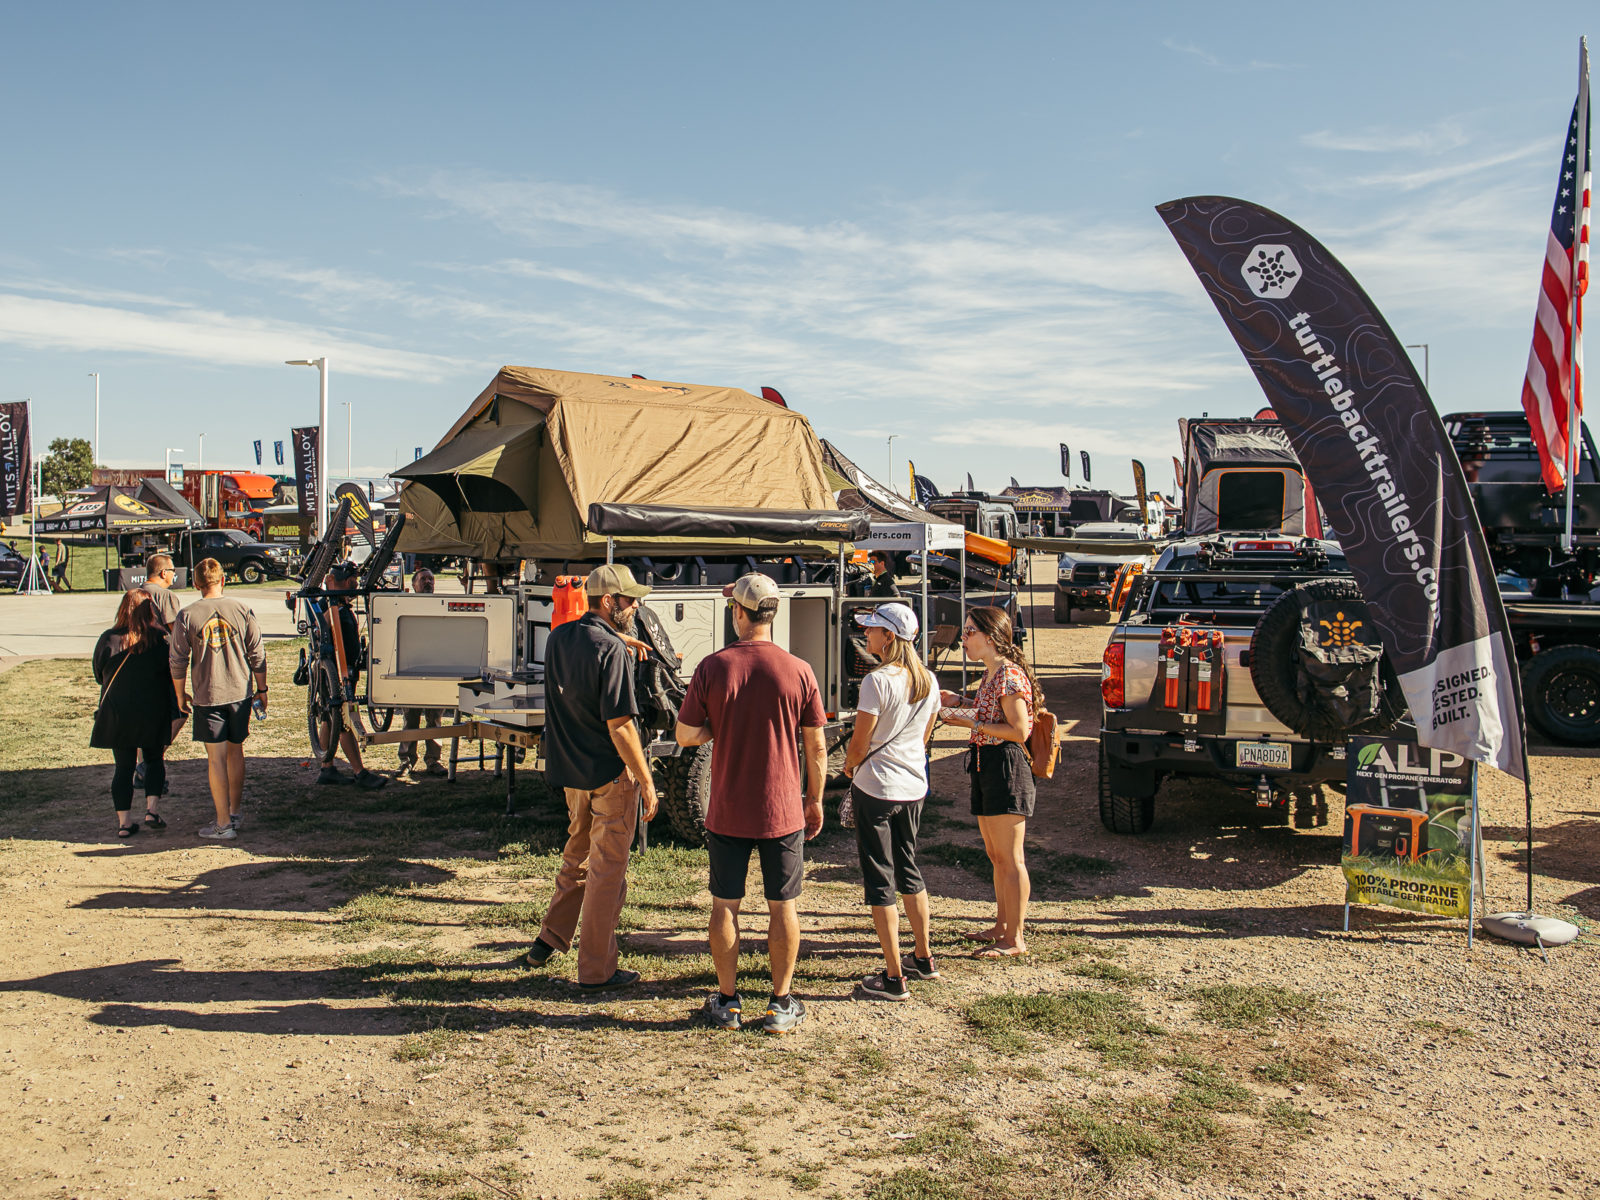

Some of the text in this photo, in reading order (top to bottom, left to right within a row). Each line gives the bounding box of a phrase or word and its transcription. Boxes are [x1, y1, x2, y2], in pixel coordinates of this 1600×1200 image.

[302, 434, 315, 511] MITS ALLOY
[1288, 311, 1441, 629] turtlebacktrailers.com
[5, 473, 16, 509] MITS
[1433, 687, 1482, 711] ESTED.
[1244, 748, 1288, 763] PNA8D9A
[1357, 743, 1464, 776] ALP
[1356, 770, 1373, 778] NEXT
[1388, 773, 1418, 782] PROPANE
[1419, 776, 1462, 784] GENERATORS
[1355, 874, 1458, 899] 100% PROPANE
[1357, 886, 1458, 908] PORTABLE GENERATOR
